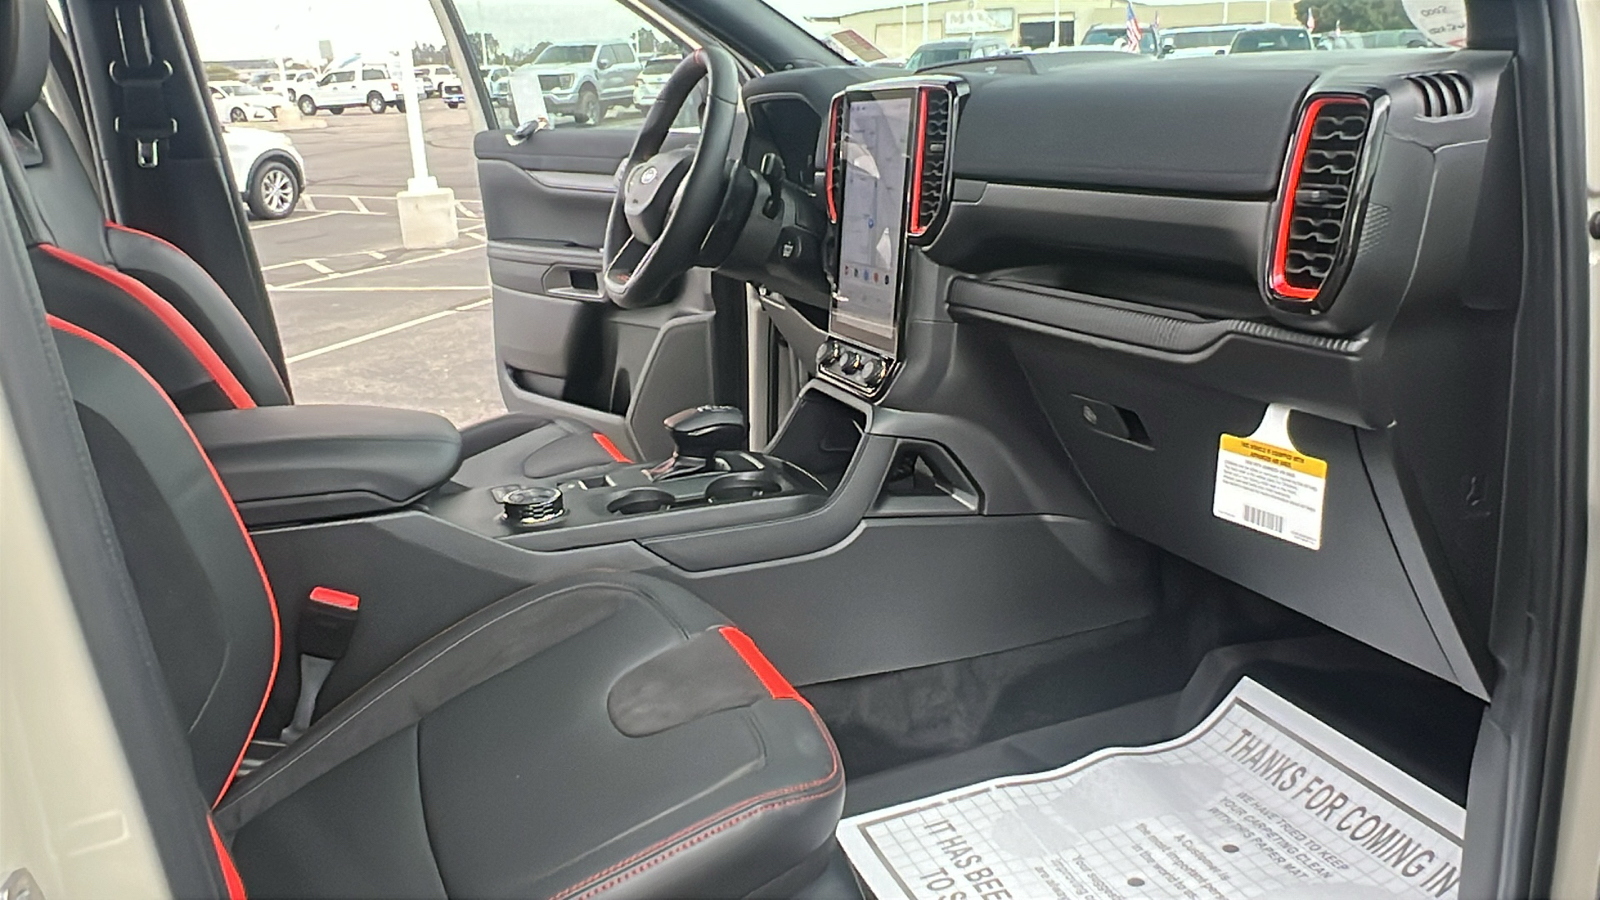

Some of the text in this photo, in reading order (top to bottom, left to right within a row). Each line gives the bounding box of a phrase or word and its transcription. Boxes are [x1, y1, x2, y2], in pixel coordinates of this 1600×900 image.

[924, 819, 956, 836] IT
[1224, 728, 1460, 898] THANKS FOR COMING IN
[936, 835, 982, 869] HAS
[1221, 796, 1333, 879] YOUR CARPETING CLEAN
[1251, 801, 1280, 820] HAVE
[1277, 818, 1307, 841] TRIED
[1304, 839, 1322, 852] TO
[1319, 850, 1350, 871] KEEP
[920, 867, 955, 891] TO
[1253, 837, 1287, 863] PAPER
[1283, 863, 1310, 879] MAT
